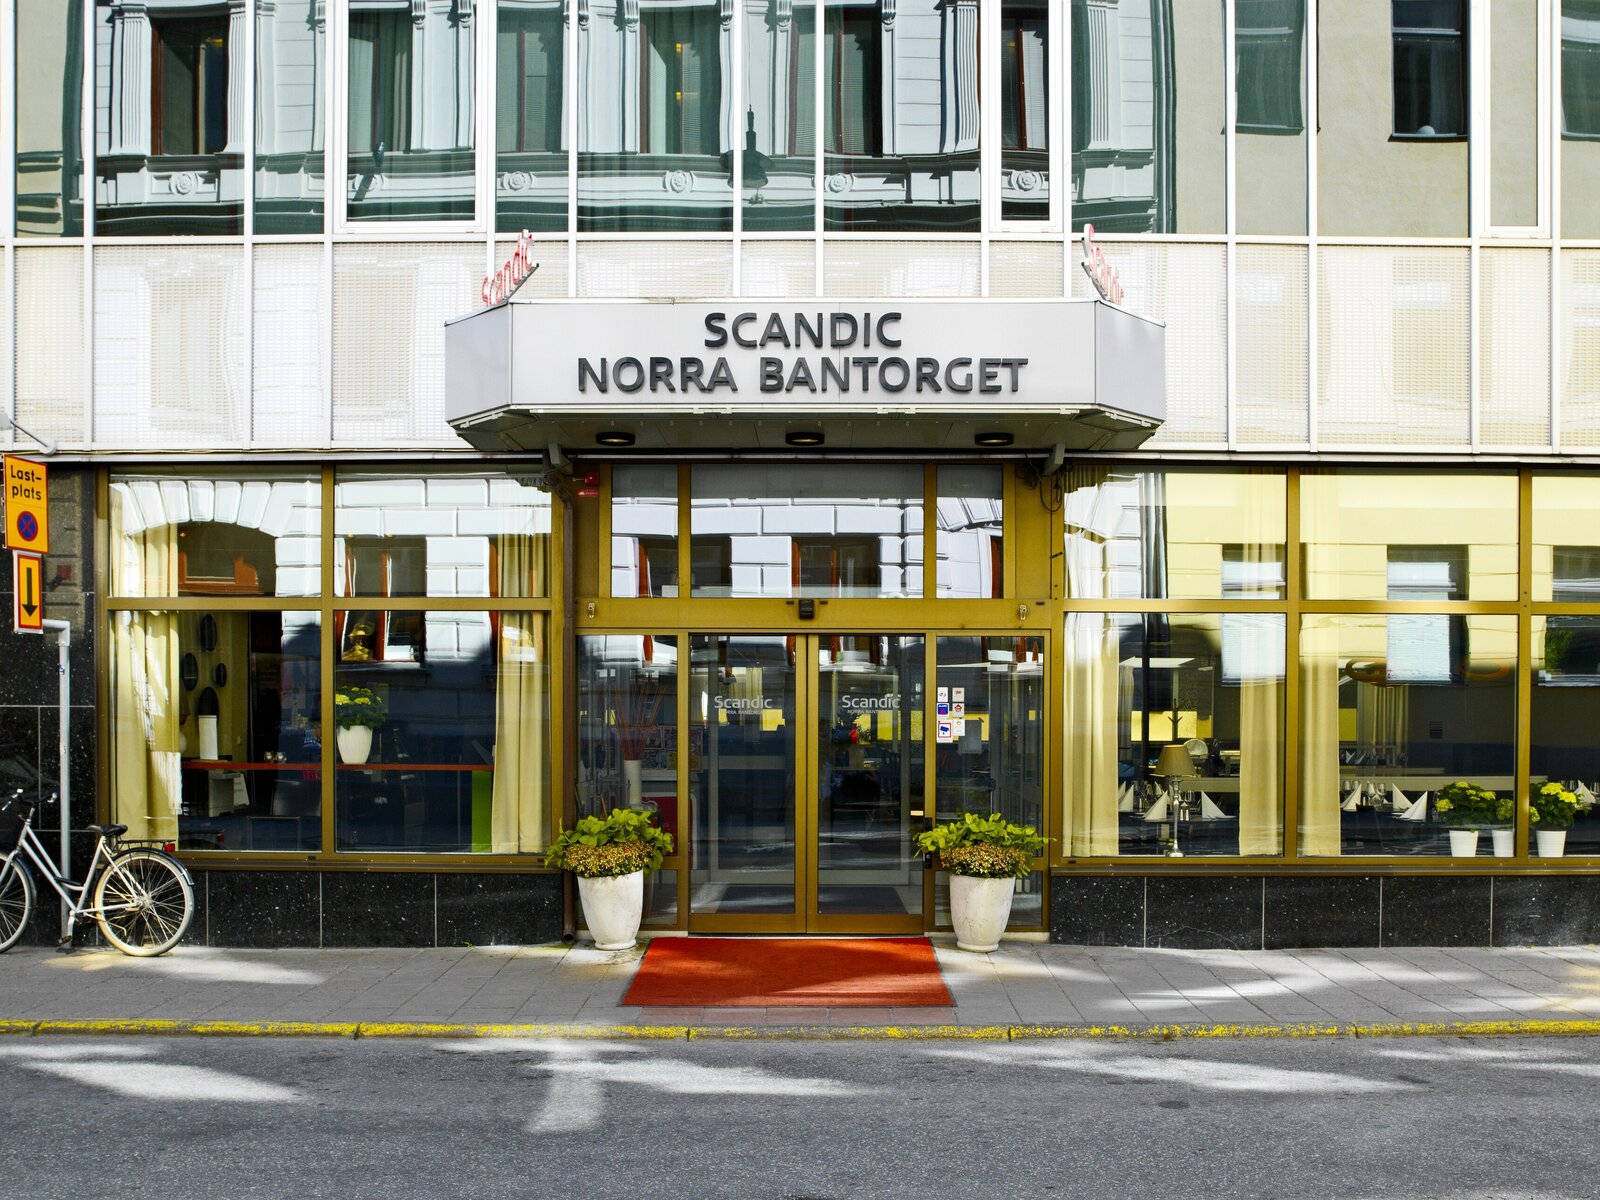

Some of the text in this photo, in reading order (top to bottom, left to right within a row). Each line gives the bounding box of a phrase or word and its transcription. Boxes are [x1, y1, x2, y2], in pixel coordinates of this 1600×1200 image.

[704, 312, 902, 349] SCANDIC
[577, 356, 1029, 393] NORRA BANTORGET
[10, 464, 42, 482] Last-
[12, 484, 42, 501] plats
[713, 695, 773, 709] Scandic
[841, 694, 901, 709] Scandic
